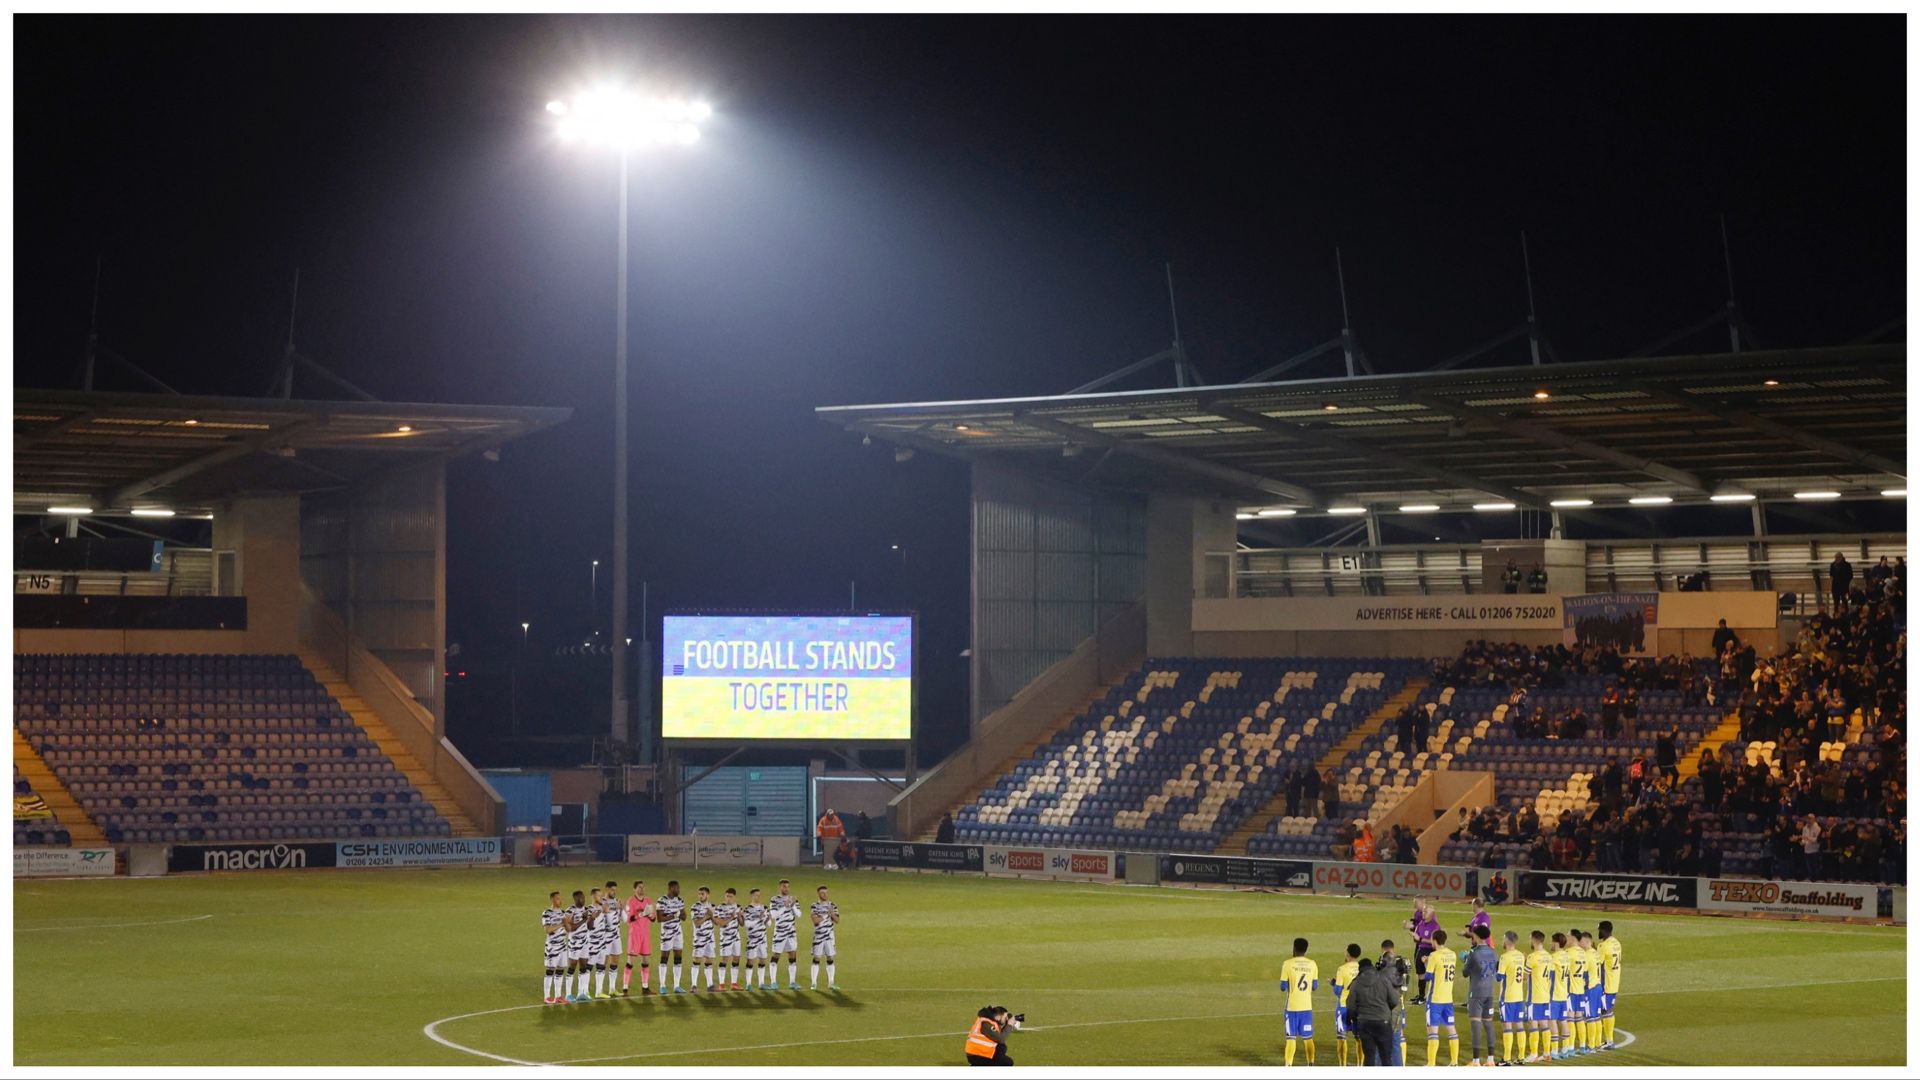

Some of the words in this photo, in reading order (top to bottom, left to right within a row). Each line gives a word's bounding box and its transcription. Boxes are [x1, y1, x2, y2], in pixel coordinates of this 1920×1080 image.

[1342, 555, 1358, 570] E1
[30, 574, 50, 590] N5
[1356, 607, 1413, 620] ADVERTISE
[1415, 607, 1442, 620] HERE
[1451, 607, 1477, 619] CALL
[1480, 606, 1513, 619] 01206
[1515, 606, 1556, 619] 752020
[683, 640, 799, 670] FOOTBALL
[806, 640, 895, 670] STANDS
[729, 682, 848, 711] TOGETHER
[24, 852, 35, 860] the
[341, 844, 379, 856] CSH
[383, 841, 472, 856] ENVIRONMENTAL
[477, 840, 495, 854] LTD
[864, 847, 884, 855] GREENE
[885, 847, 899, 855] KING
[902, 845, 915, 857] IPA
[928, 849, 948, 857] GREENE
[950, 850, 965, 858] KING
[967, 848, 980, 860] IPA
[204, 844, 306, 870] macron
[346, 858, 366, 866] 01206
[990, 852, 1007, 868] sky
[1009, 855, 1041, 869] sports
[1052, 855, 1070, 871] sky
[1072, 857, 1107, 872] sports
[1185, 862, 1221, 874] REGENCY
[1315, 866, 1384, 887] CAZOO
[1392, 869, 1462, 892] CAZOO
[1545, 878, 1643, 900] STRIKERZ
[1645, 882, 1680, 902] INC.
[1709, 880, 1780, 904] TEXO
[1781, 889, 1864, 911] Scaffolding
[1443, 964, 1456, 982] 18
[1515, 966, 1523, 983] 8
[1297, 973, 1308, 991] 6
